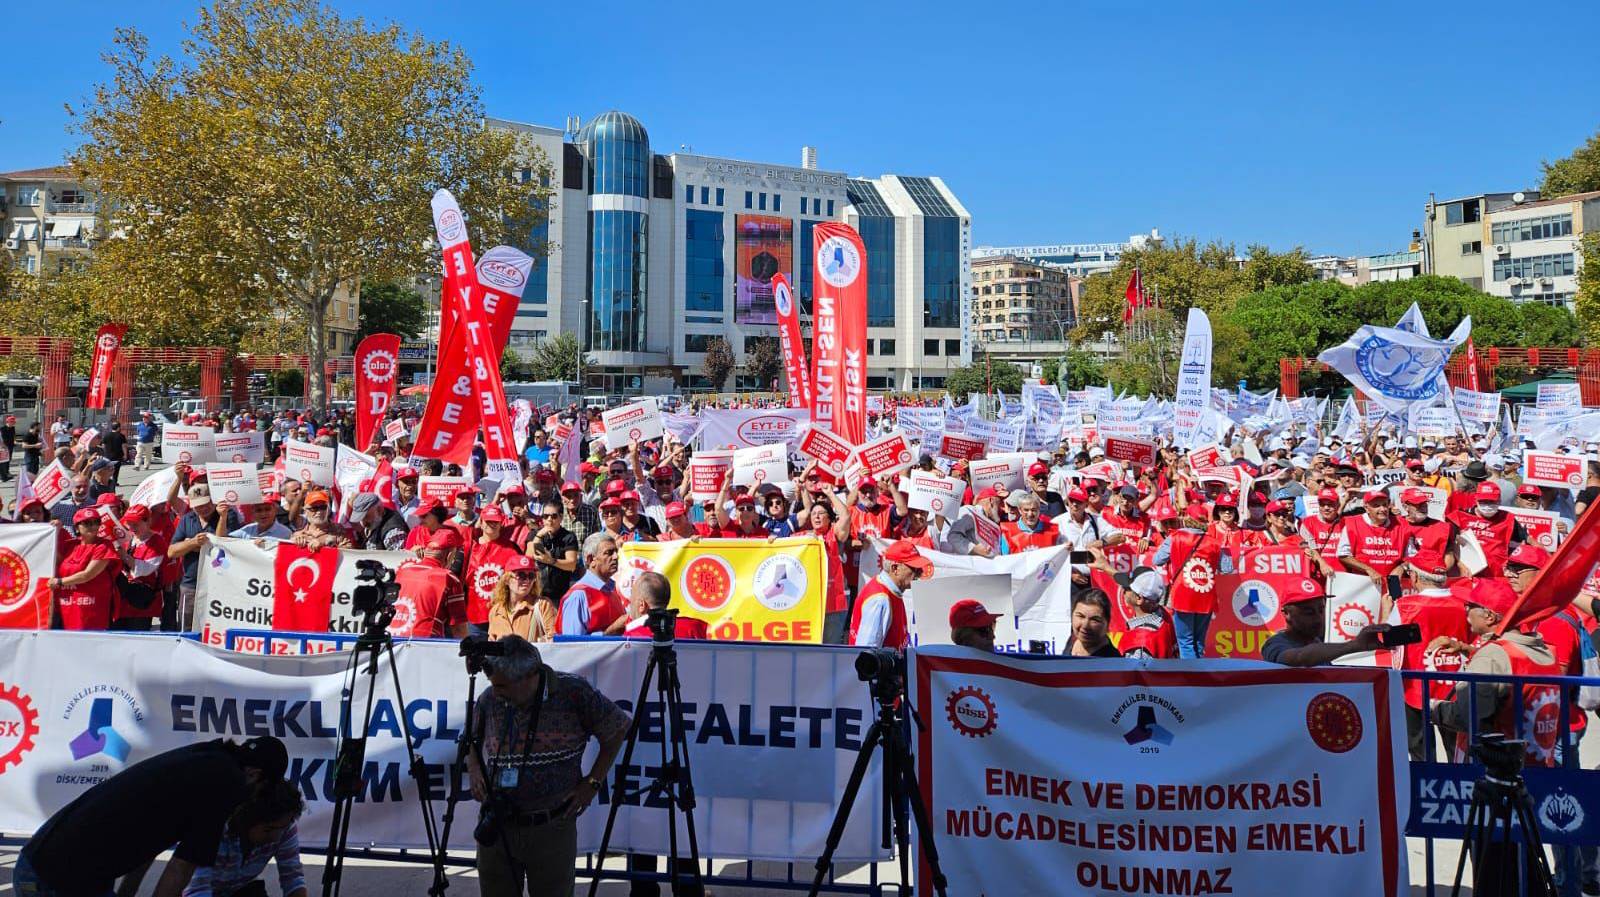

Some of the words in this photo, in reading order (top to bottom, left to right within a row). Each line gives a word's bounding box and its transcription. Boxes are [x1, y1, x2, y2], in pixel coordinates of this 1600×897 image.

[751, 421, 790, 431] EYT-EF
[1366, 536, 1392, 546] DİSK
[1107, 548, 1145, 573] İSK
[1254, 553, 1302, 574] SEN
[209, 599, 274, 627] Sendik
[1343, 616, 1366, 628] DİSK
[708, 616, 812, 642] ÖLGE
[1434, 653, 1461, 667] DİSK
[63, 684, 108, 720] EMEKLİLER
[108, 685, 145, 723] SENDİKASI
[957, 703, 987, 720] DİSK
[1111, 693, 1147, 725] EMEKLİLER
[1148, 694, 1185, 724] SENDİKASI
[1139, 746, 1160, 755] 2019
[91, 764, 109, 773] 2019
[985, 768, 1072, 808] EMEK
[1081, 780, 1124, 811] VE
[1135, 772, 1322, 811] DEMOKRASİ
[946, 805, 1237, 854] MÜCADELESİNDEN
[1247, 818, 1365, 855] EMEKLİ
[1076, 861, 1233, 895] OLUNMAZ
